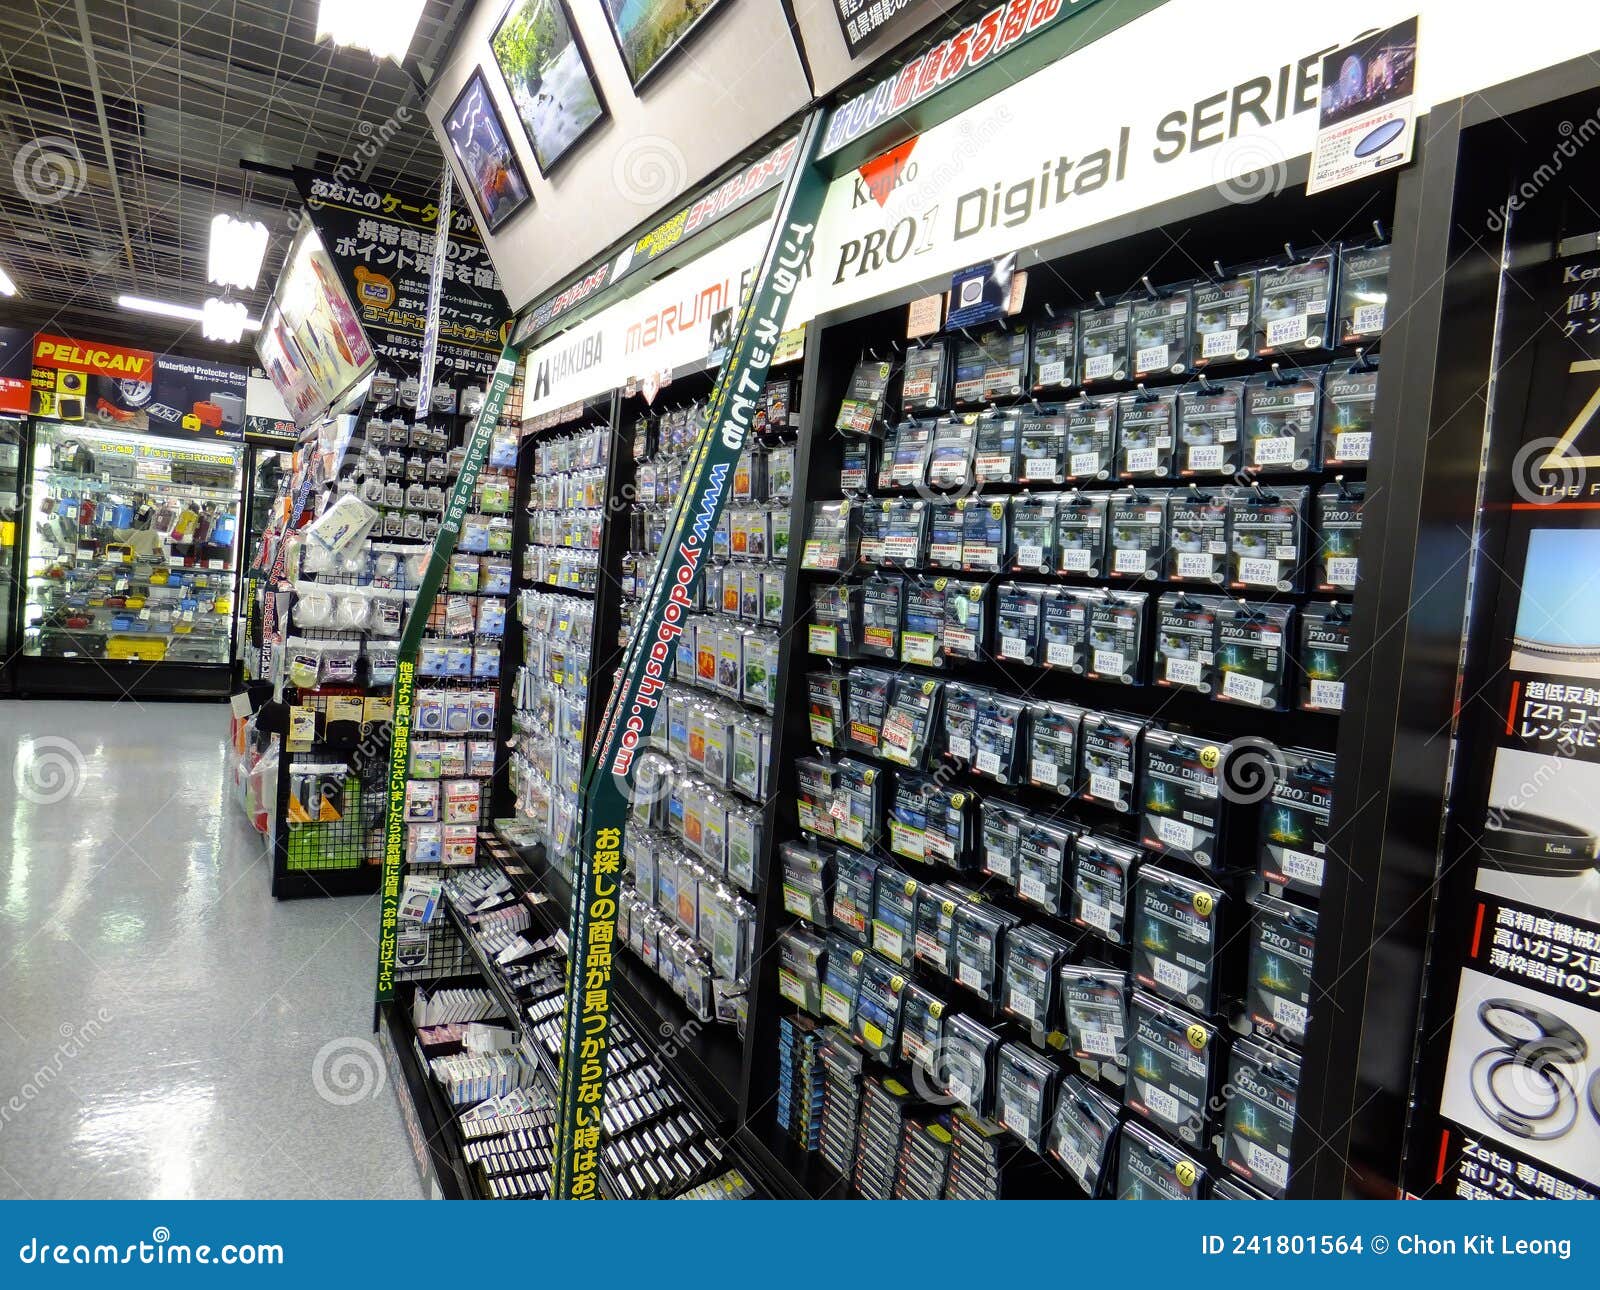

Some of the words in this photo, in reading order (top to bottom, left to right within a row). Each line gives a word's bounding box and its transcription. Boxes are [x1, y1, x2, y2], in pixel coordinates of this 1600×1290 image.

[832, 204, 940, 285] PRO1
[953, 127, 1130, 242] Digital
[1153, 28, 1381, 163] SERIE
[853, 156, 919, 208] Kenko
[310, 178, 480, 234] あなたのケータが
[36, 341, 144, 373] PELICAN
[551, 331, 603, 384] HAKUBA
[158, 360, 196, 374] Watertight
[196, 365, 228, 379] Protector
[229, 370, 246, 381] Case
[1539, 484, 1580, 496] THE
[611, 462, 730, 777] www.yodobashi.com
[1521, 721, 1600, 747] レンズに
[1203, 751, 1217, 763] 62
[1182, 768, 1218, 785] Digital
[1196, 896, 1209, 910] 67
[1175, 911, 1209, 928] Digital
[1191, 1029, 1204, 1045] 72
[1462, 1137, 1514, 1174] Zeta
[1178, 1165, 1194, 1181] 77
[1459, 1160, 1549, 1200] ポリカー
